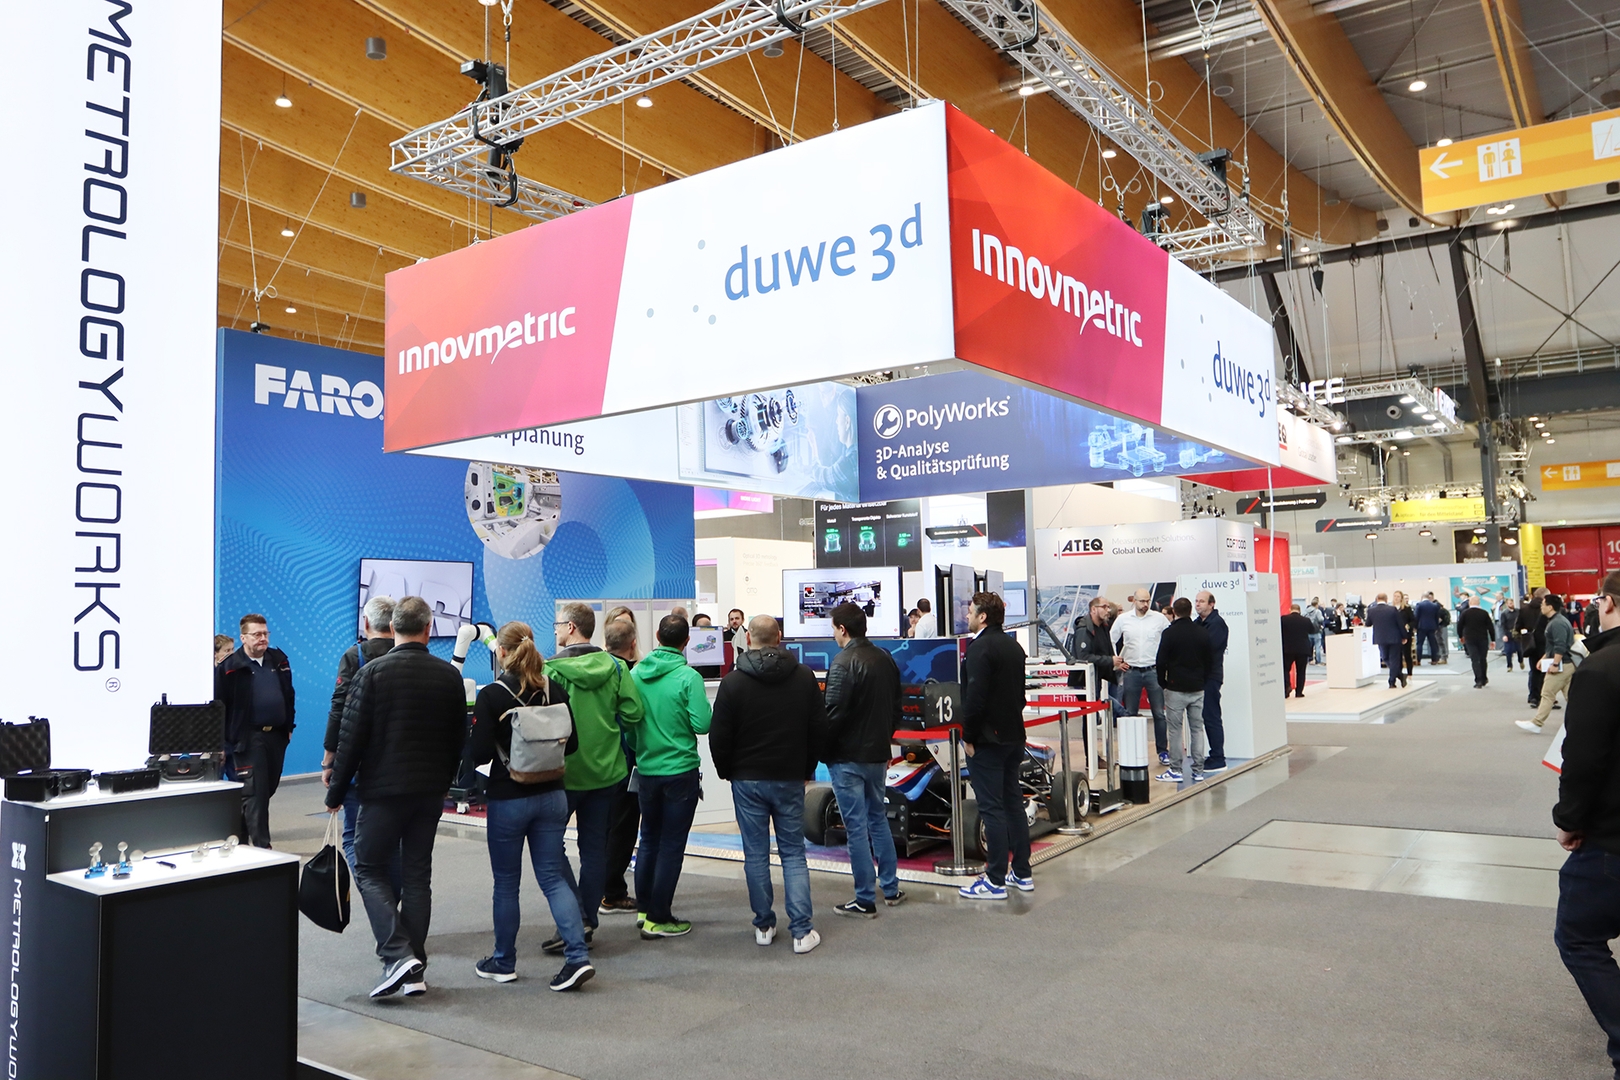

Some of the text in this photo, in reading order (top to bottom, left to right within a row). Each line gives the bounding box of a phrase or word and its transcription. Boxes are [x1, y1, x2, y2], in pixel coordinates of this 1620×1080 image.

[724, 202, 923, 301] duwe 3d
[254, 363, 384, 420] FARO
[1213, 340, 1271, 418] duwe 3d
[875, 440, 950, 464] 3D-Analyse
[876, 453, 1010, 481] & Qualitätsprüfung
[1062, 538, 1104, 552] ATEQ
[1112, 537, 1159, 545] Measurement
[1112, 545, 1163, 555] Global Leader.
[1202, 579, 1228, 589] duwe
[1230, 578, 1240, 590] 3d
[935, 695, 953, 723] 13
[8, 878, 23, 1080] METROLOGYWO
